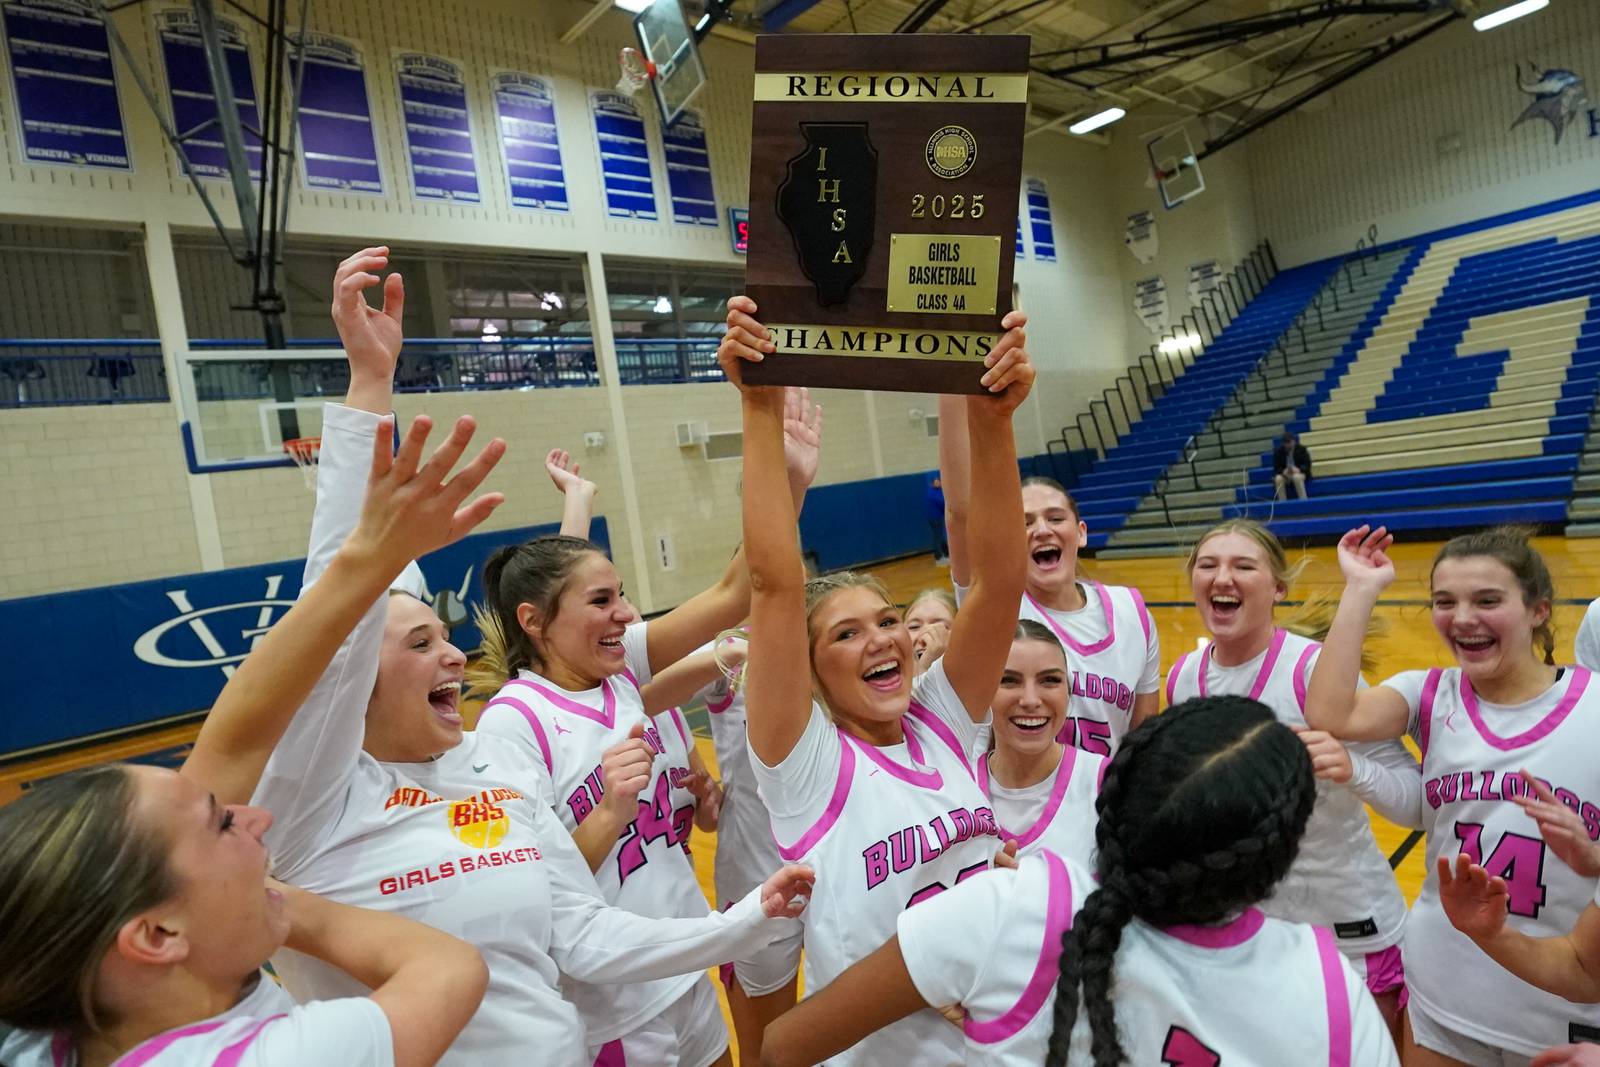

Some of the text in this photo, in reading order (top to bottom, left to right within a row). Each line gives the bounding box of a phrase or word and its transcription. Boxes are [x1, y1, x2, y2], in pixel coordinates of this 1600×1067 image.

[786, 75, 994, 99] REGIONAL
[911, 193, 985, 219] 2025
[928, 243, 960, 262] GIRLS
[908, 266, 977, 286] BASKETBALL
[916, 293, 966, 311] CLASS 4A
[453, 802, 504, 827] BHS
[379, 861, 456, 896] GIRLS
[1454, 820, 1547, 920] 14
